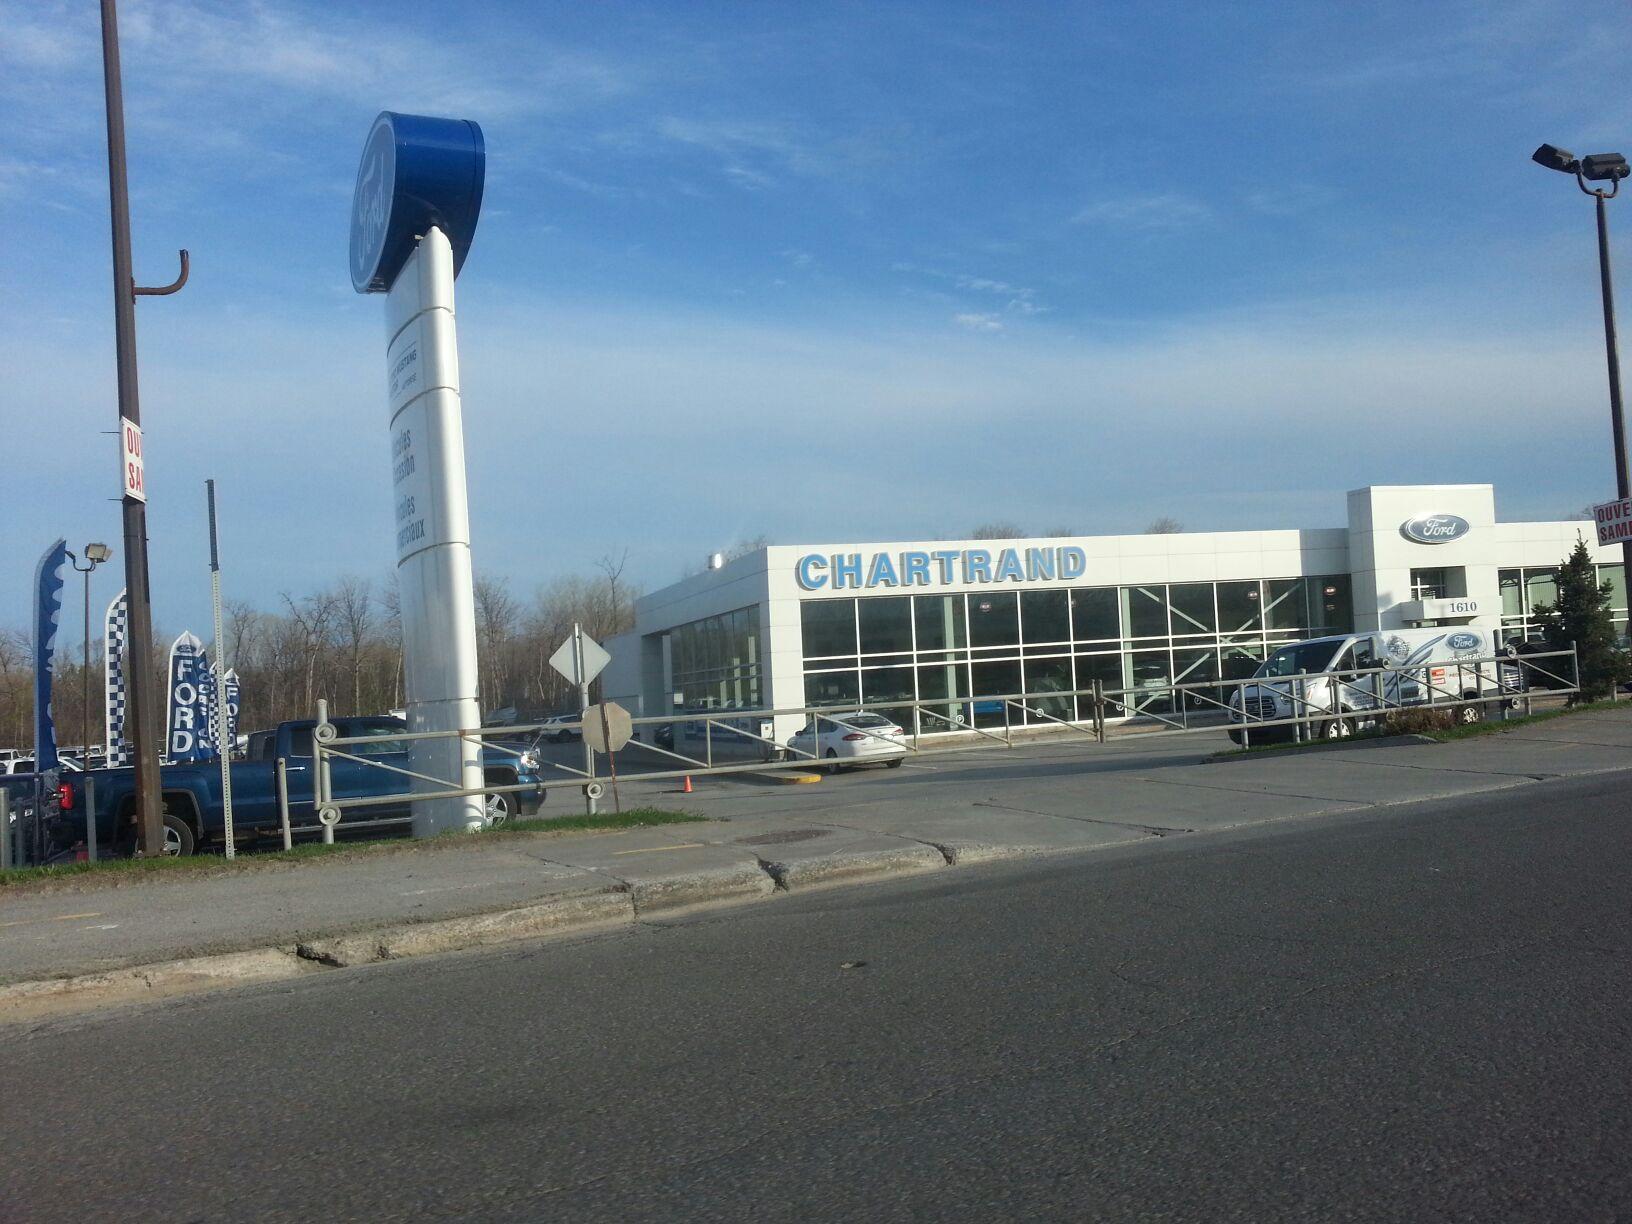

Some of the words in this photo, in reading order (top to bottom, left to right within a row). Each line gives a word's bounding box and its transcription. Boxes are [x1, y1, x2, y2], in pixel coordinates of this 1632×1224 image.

[1423, 518, 1456, 535] Ford
[797, 546, 1087, 590] CHARTRAND
[1449, 601, 1477, 613] 1610
[1453, 636, 1474, 647] Ford
[171, 659, 198, 753] FORD
